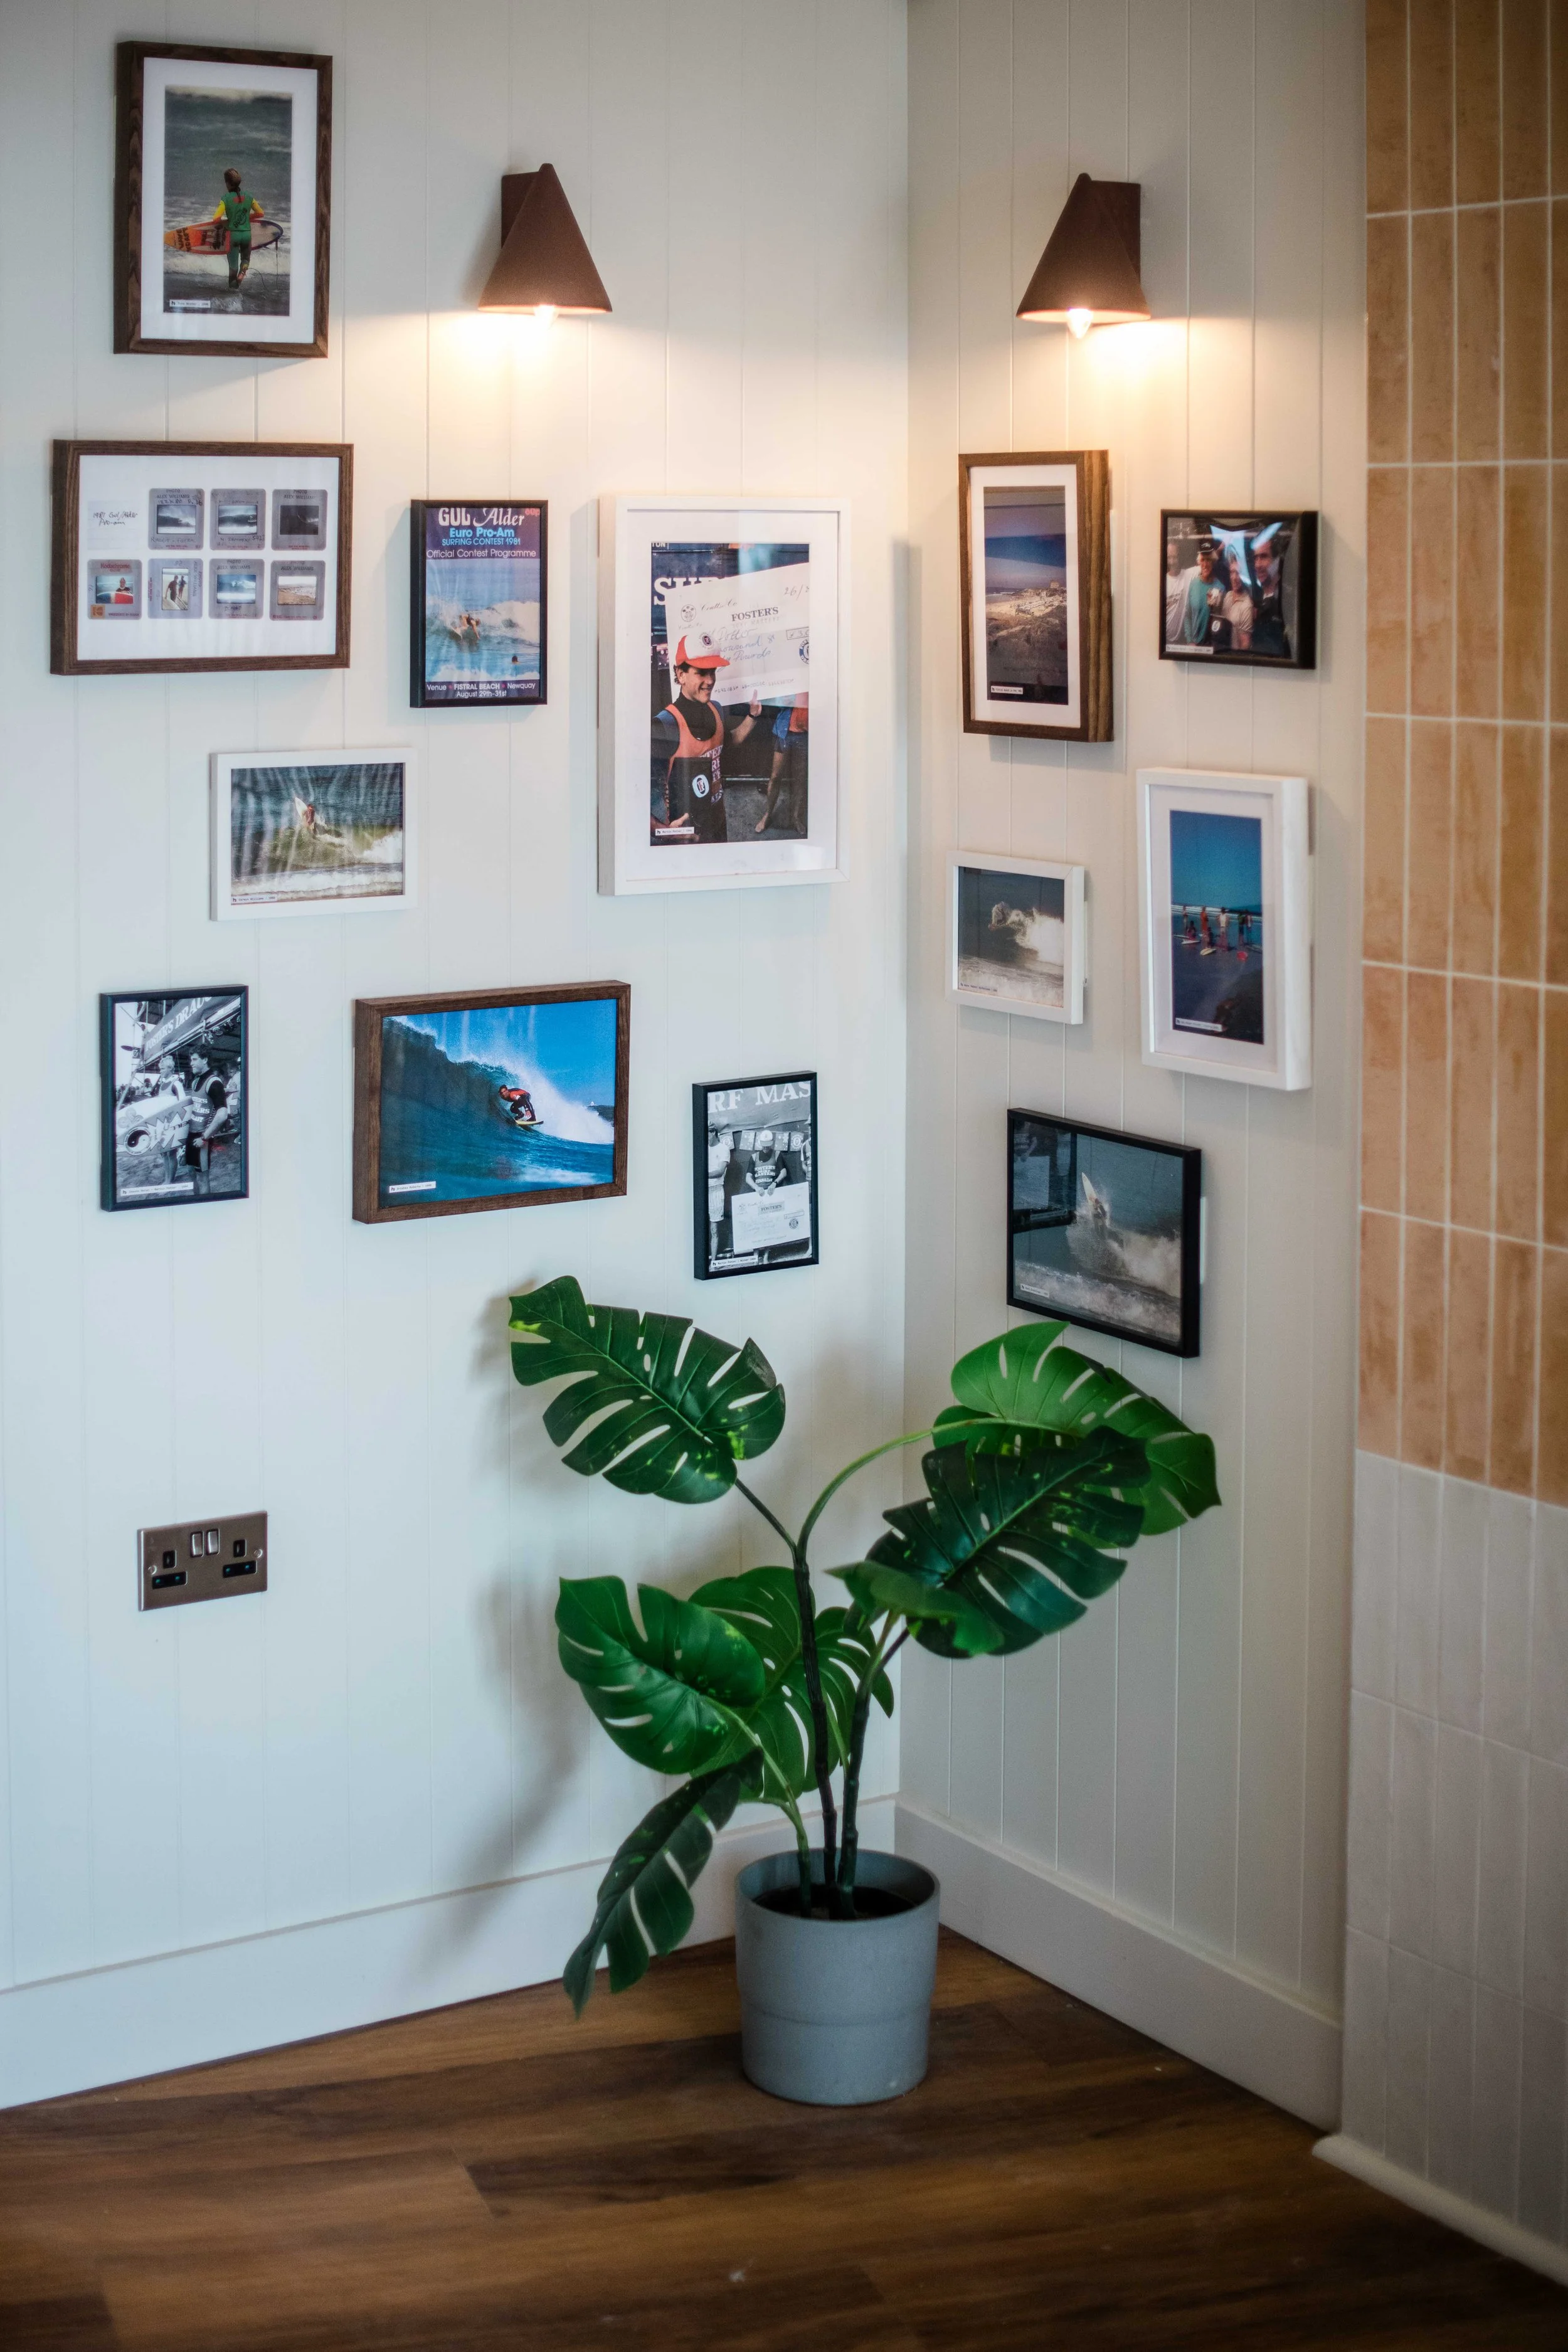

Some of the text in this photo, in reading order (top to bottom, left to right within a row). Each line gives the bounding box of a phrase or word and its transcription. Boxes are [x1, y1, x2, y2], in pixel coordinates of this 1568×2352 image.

[438, 507, 524, 526] GUL Alder
[450, 527, 515, 538] Euro Pro-Am
[442, 538, 472, 546] SURFING
[426, 549, 536, 559] Official Contest Programme
[732, 607, 779, 622] FOSTER'S
[707, 1081, 810, 1113] RF MAS
[761, 1204, 782, 1212] FOSTER'S
